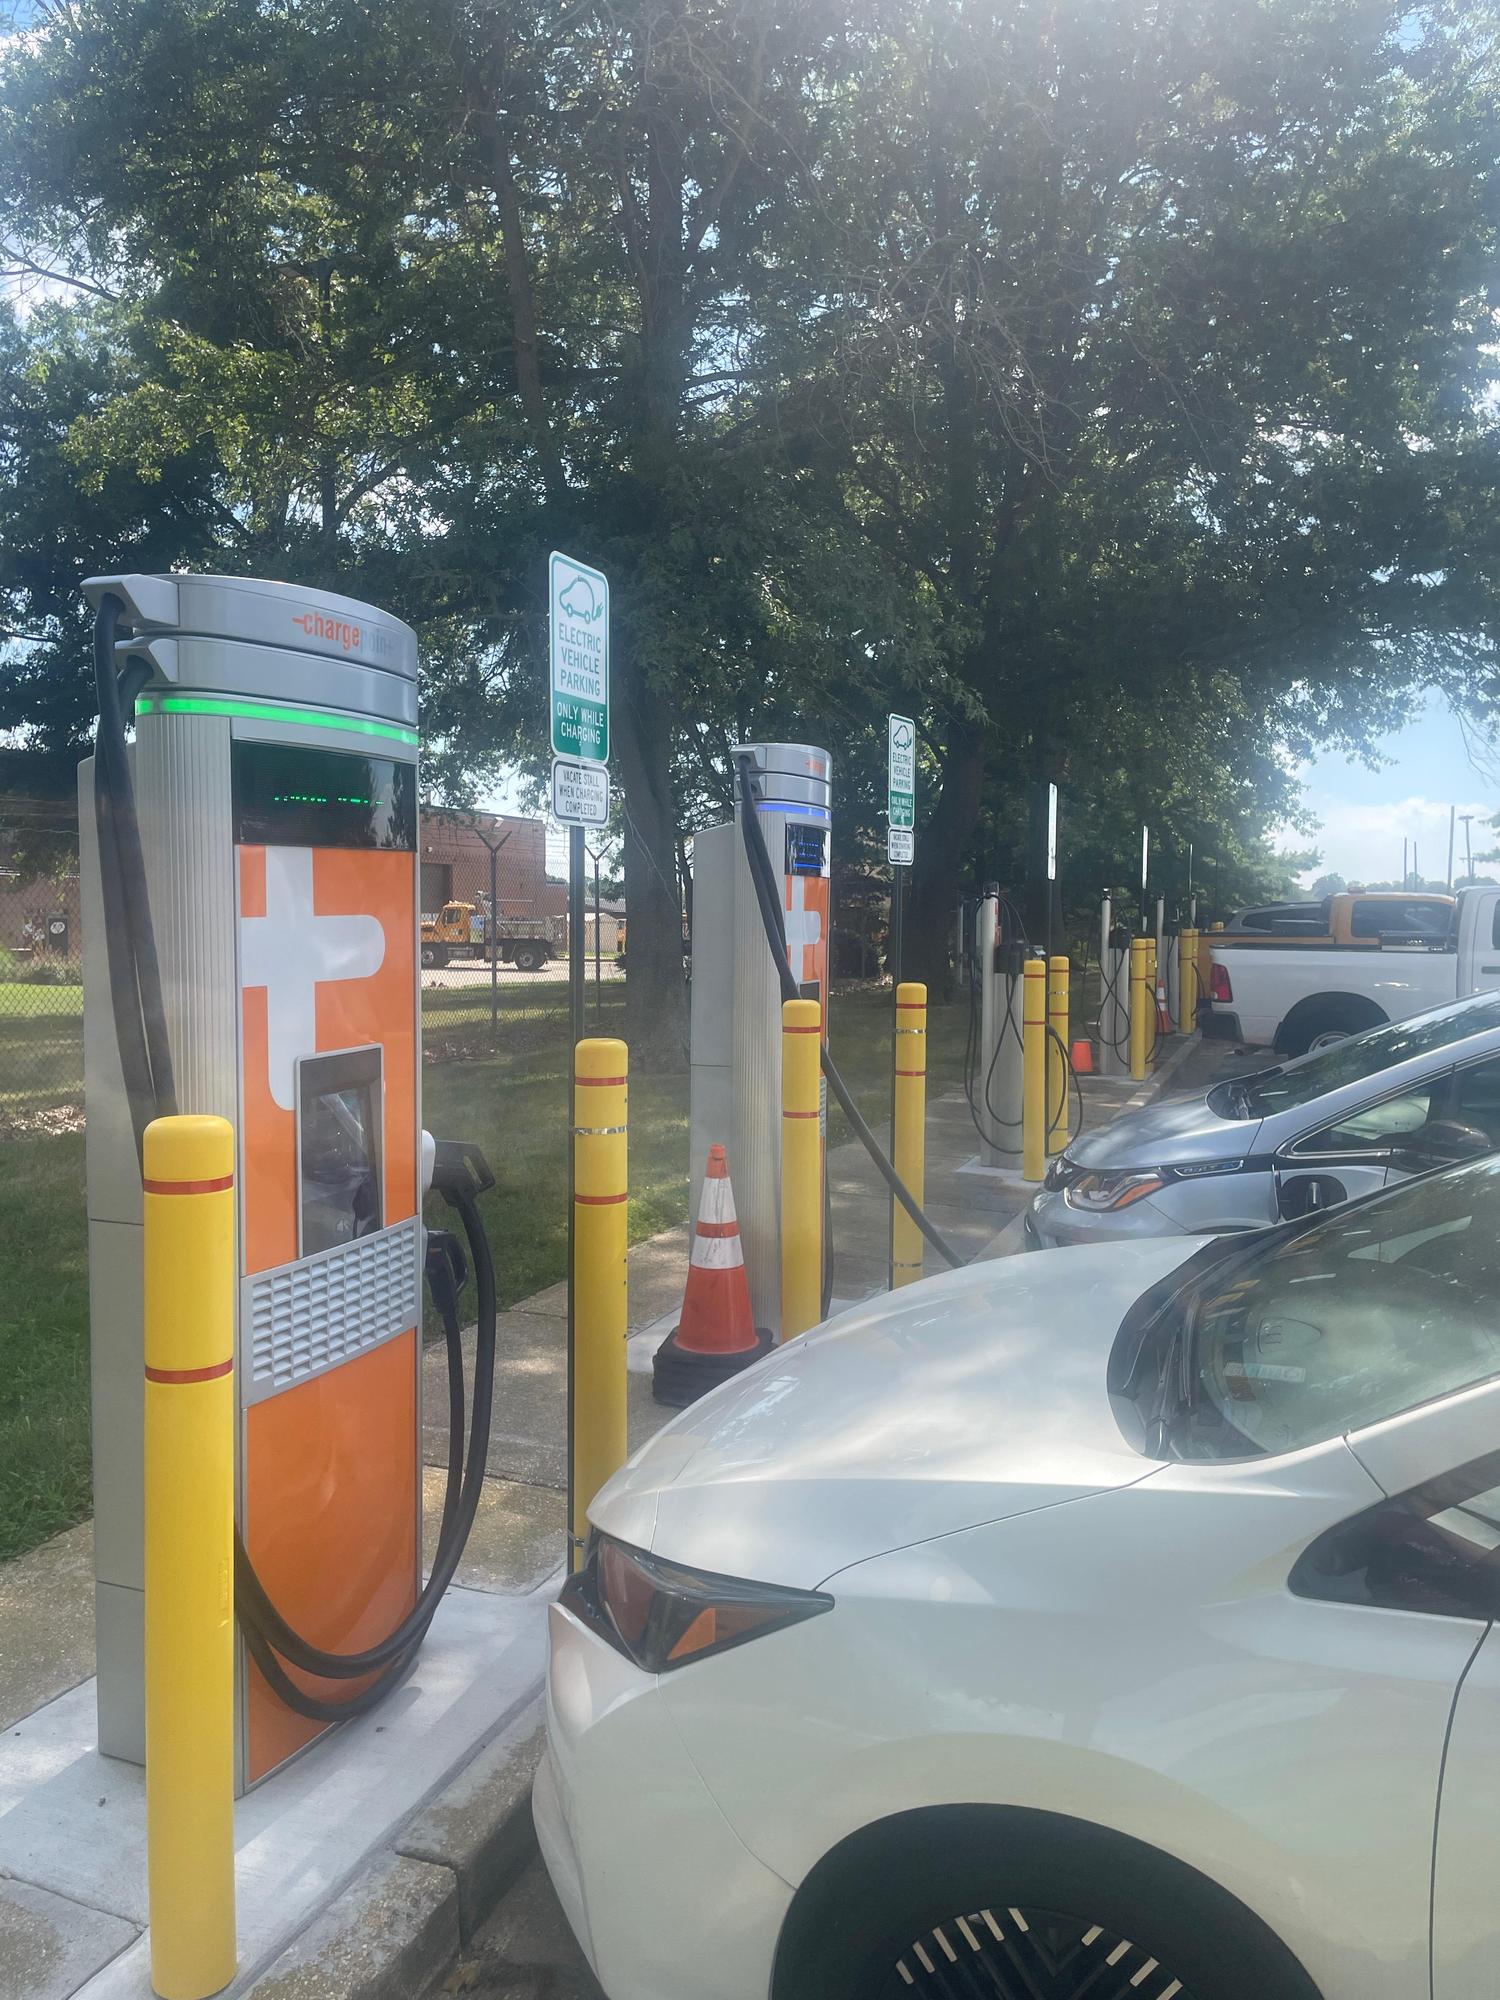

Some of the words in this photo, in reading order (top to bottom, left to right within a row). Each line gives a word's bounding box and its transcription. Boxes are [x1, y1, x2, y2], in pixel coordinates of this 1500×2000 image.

[559, 622, 602, 654] ELECTRIC
[561, 646, 600, 675] VEHICLE
[560, 668, 601, 697] PARKING
[557, 702, 579, 720] ONLY
[581, 708, 604, 728] WHILE
[561, 722, 601, 745] CHARGING
[563, 769, 582, 785] VACATE
[583, 774, 599, 788] STALL
[559, 784, 575, 799] WHEN
[576, 787, 604, 803] CHARGING
[565, 800, 598, 817] COMPLETED
